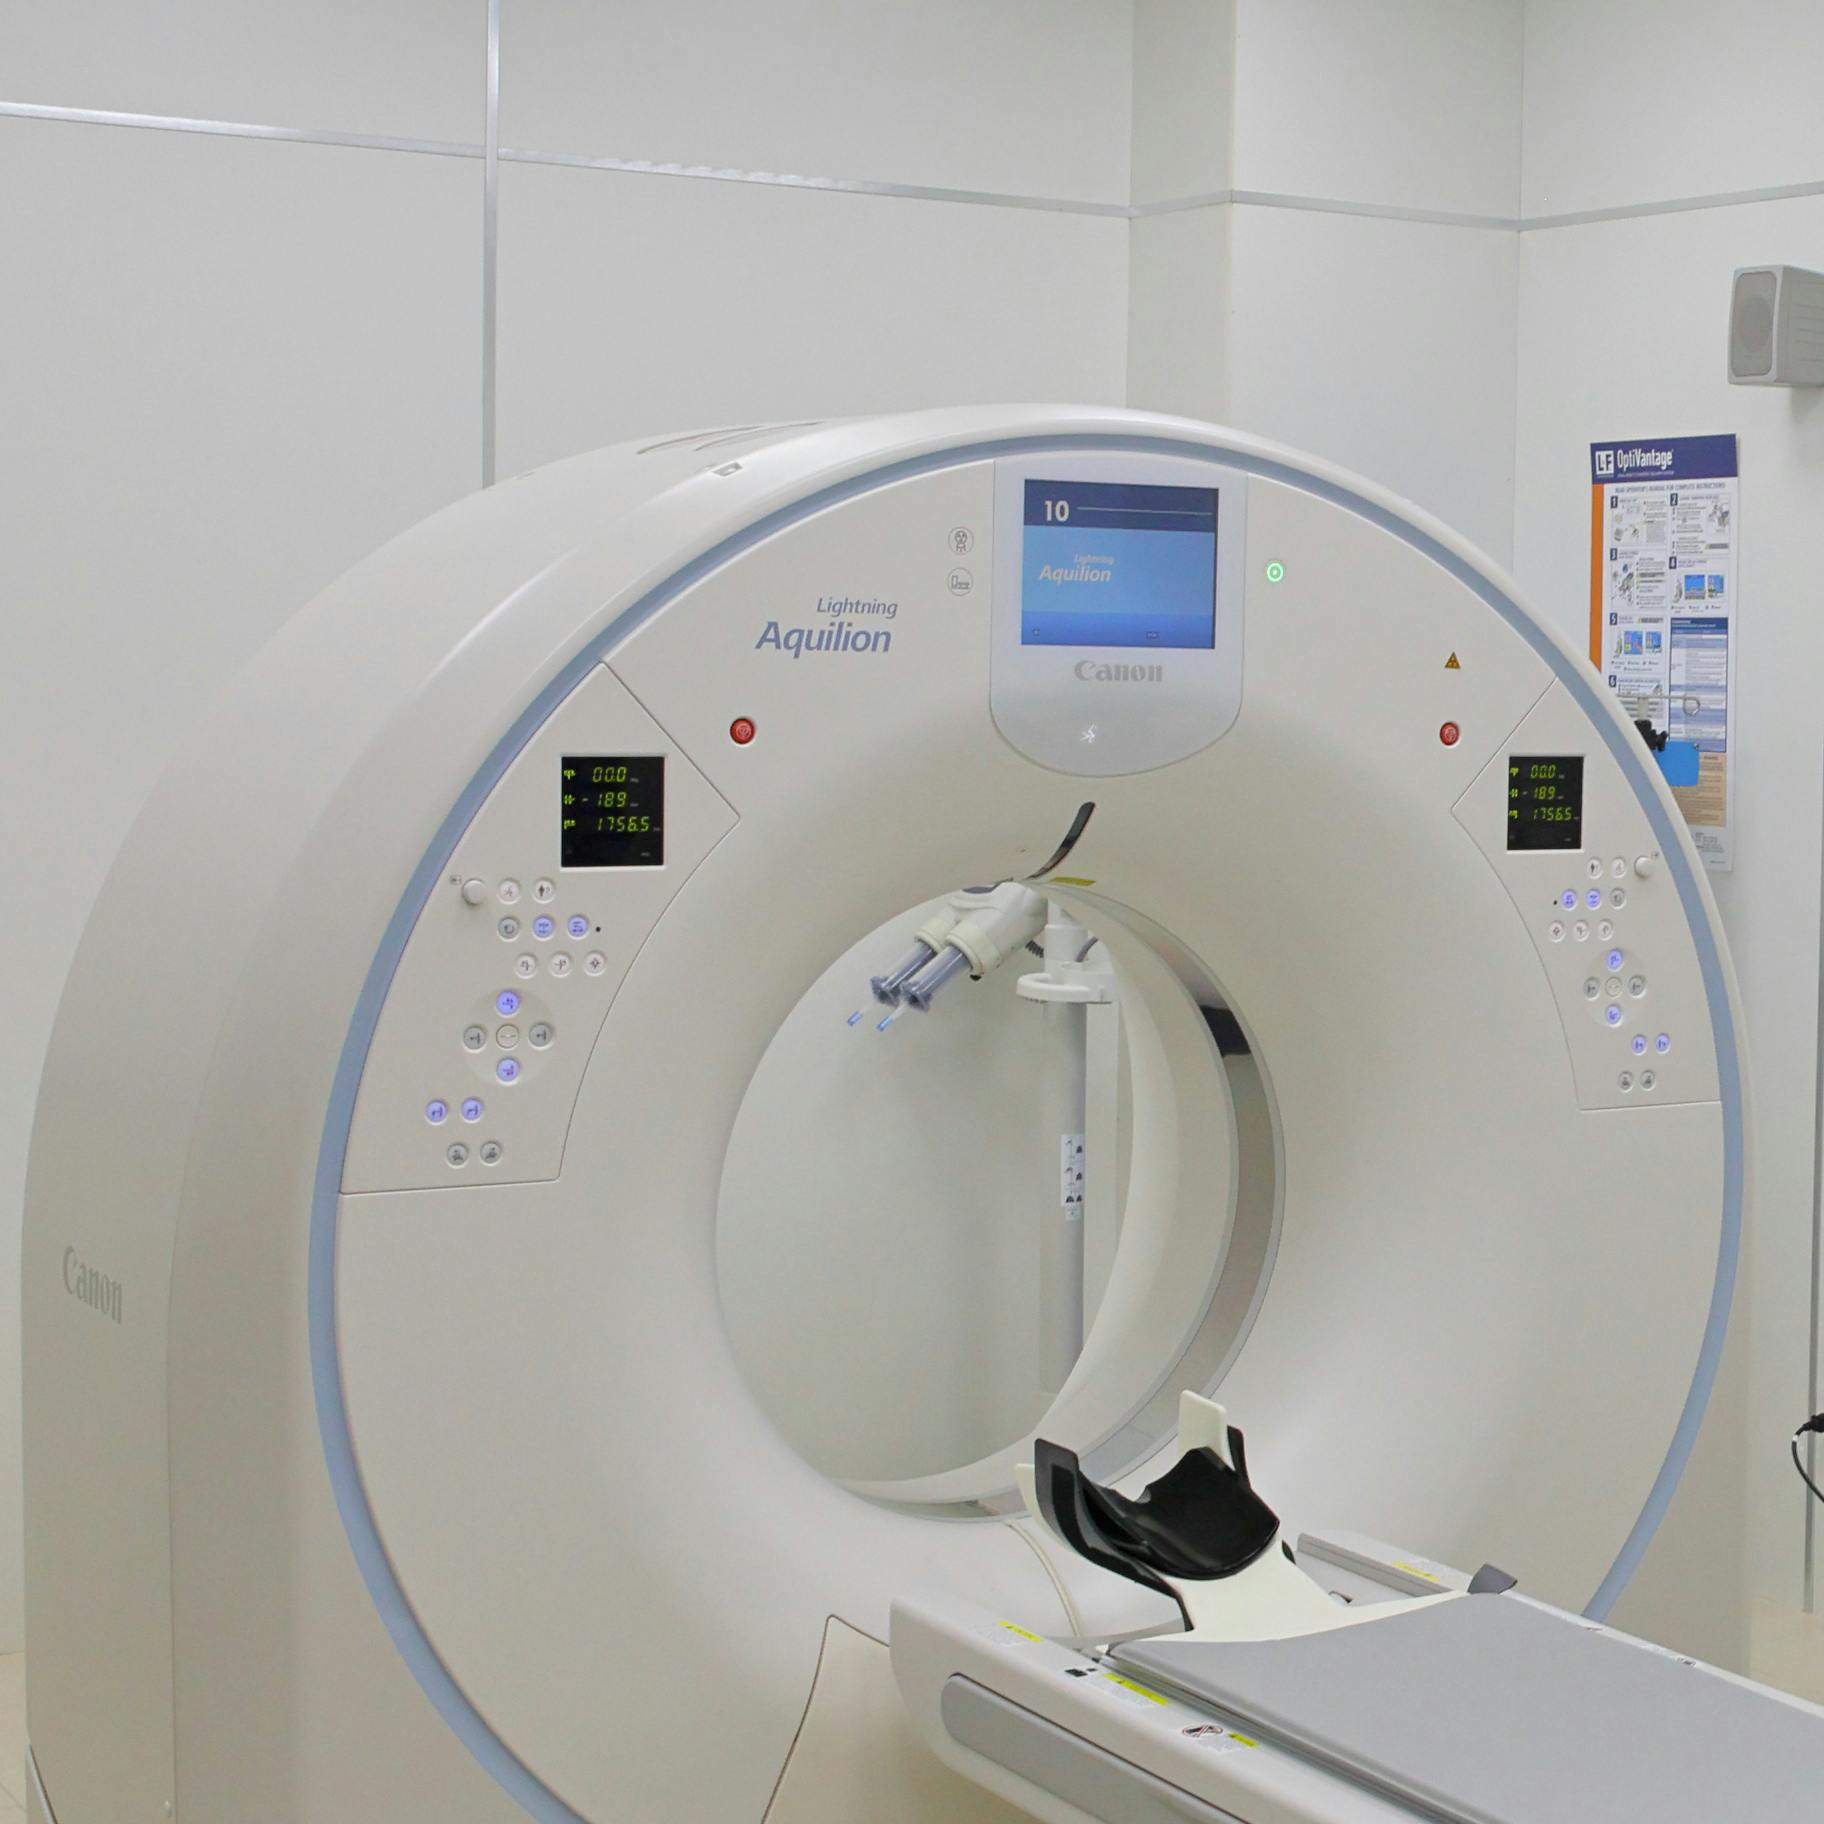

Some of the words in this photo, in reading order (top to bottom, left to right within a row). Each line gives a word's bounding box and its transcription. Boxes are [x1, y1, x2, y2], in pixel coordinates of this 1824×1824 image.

[1617, 448, 1673, 472] OptiVantage
[1044, 500, 1069, 522] 10
[1039, 564, 1111, 586] Aquilion
[816, 597, 898, 619] Lightning
[755, 621, 891, 659] Aquilion
[1074, 660, 1163, 683] Canon
[62, 1245, 123, 1325] Canon
